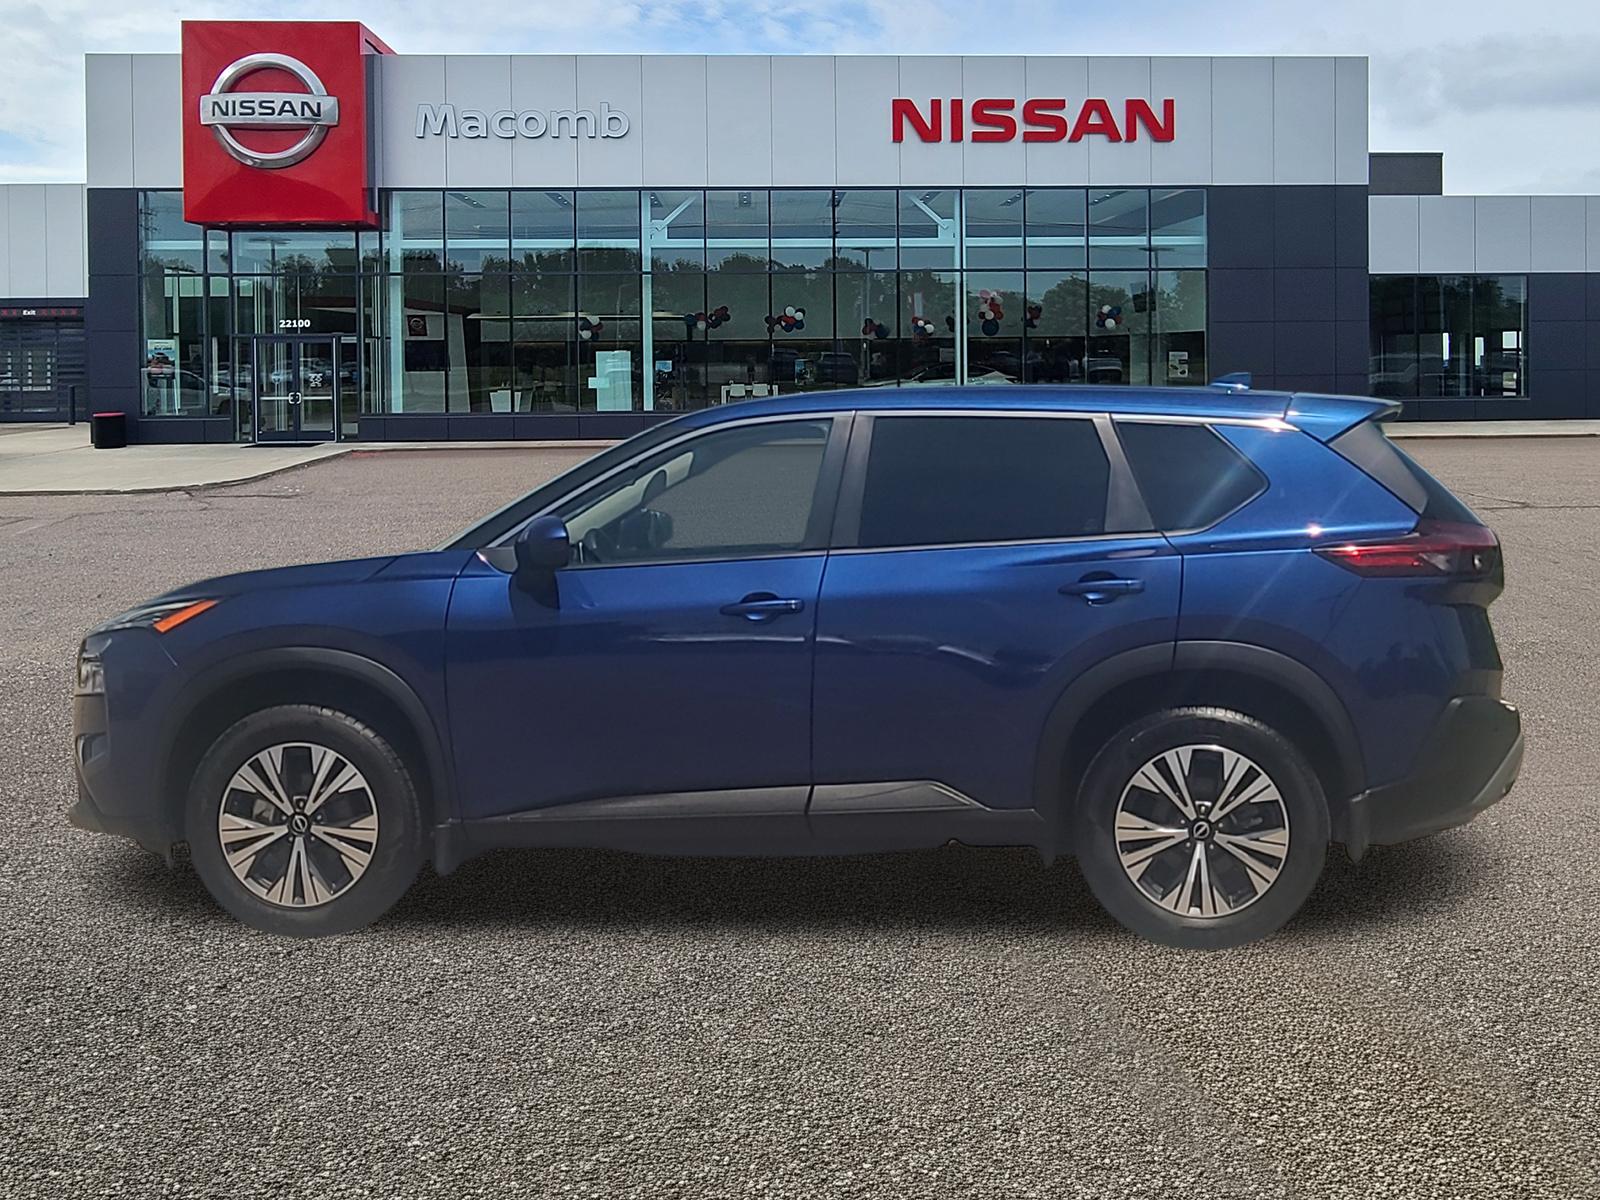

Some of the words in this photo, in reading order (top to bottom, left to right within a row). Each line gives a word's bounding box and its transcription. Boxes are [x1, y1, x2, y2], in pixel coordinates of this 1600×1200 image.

[212, 99, 321, 117] NISSAN
[415, 102, 630, 138] Macomb
[892, 98, 1174, 142] NISSAN
[279, 319, 311, 328] 22100
